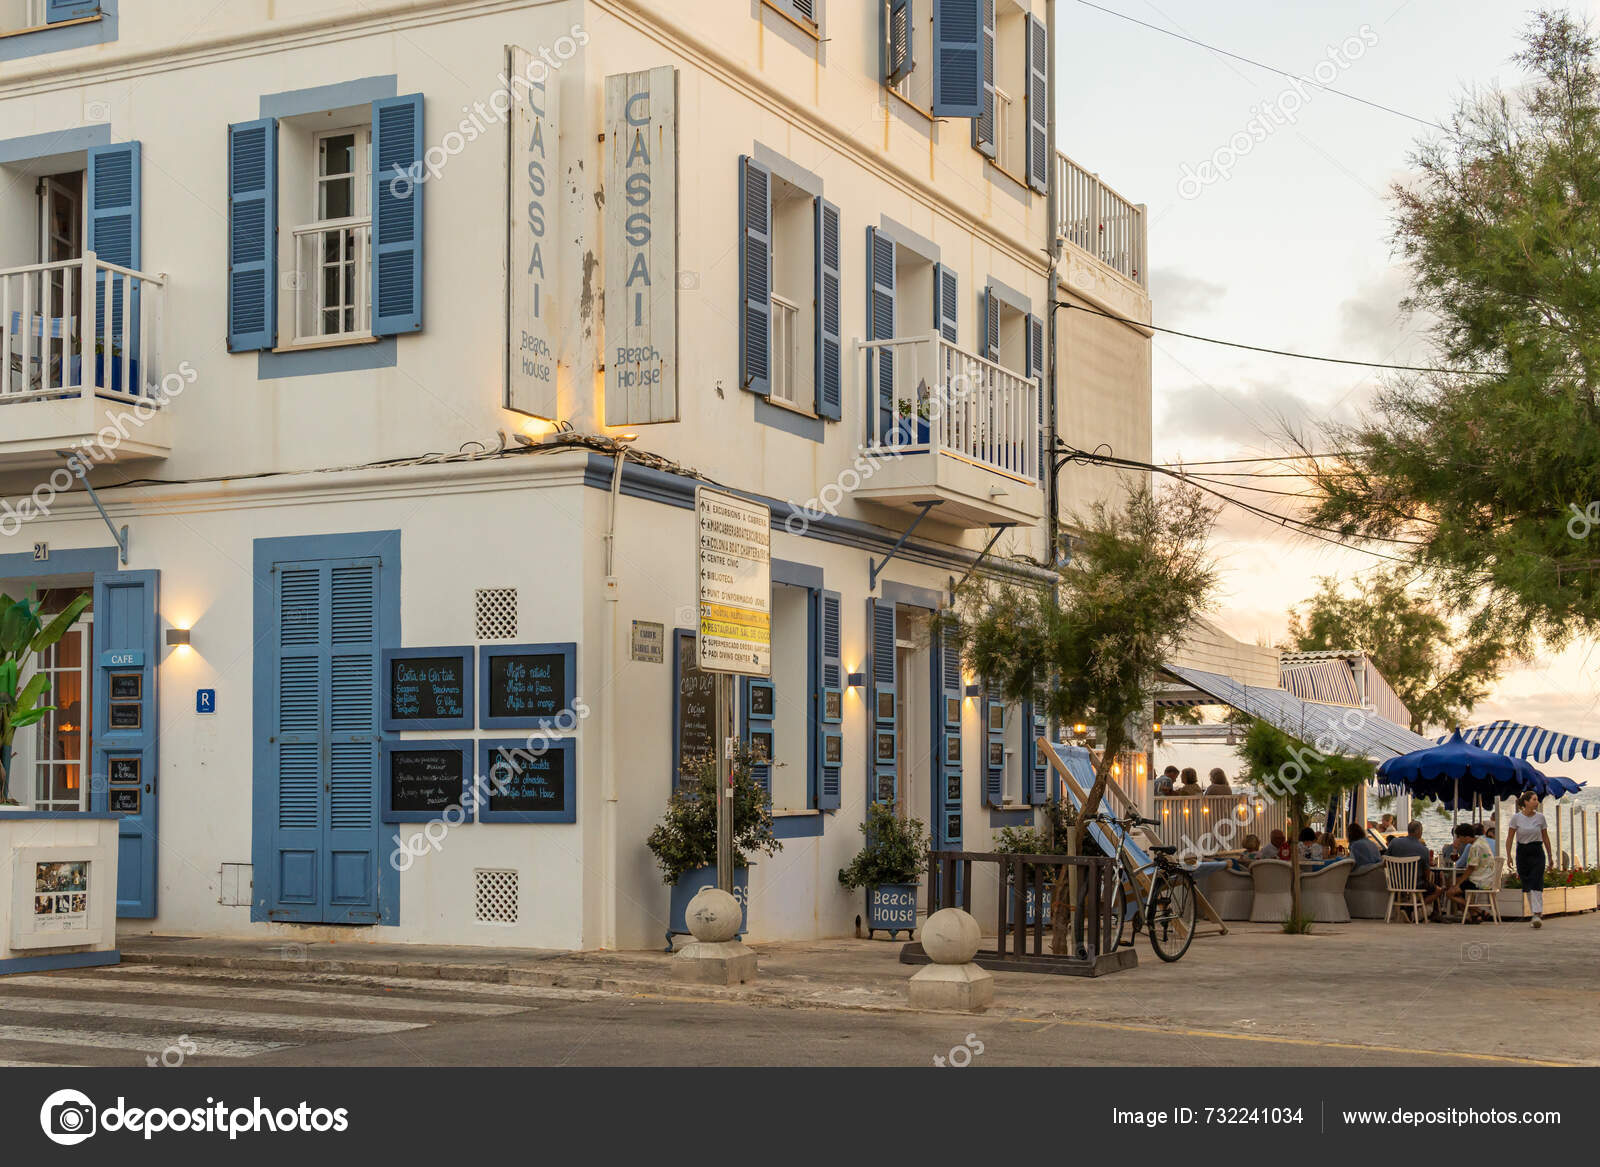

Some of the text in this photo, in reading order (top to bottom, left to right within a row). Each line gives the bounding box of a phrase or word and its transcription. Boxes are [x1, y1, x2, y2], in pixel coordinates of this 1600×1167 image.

[528, 82, 545, 318] CASSAI
[625, 92, 651, 327] CASSAI
[521, 330, 550, 357] Beach
[617, 345, 660, 365] Beach
[712, 504, 741, 520] EXCURSIONS
[748, 514, 767, 527] CABRERA
[34, 543, 47, 560] 21
[707, 554, 725, 566] CENTRE
[707, 571, 734, 584] BIBLIOTECA
[707, 588, 720, 598] PUNT
[707, 622, 739, 637] RESTAURANT
[708, 639, 739, 650] SUPERMERCADO
[708, 650, 750, 662] PADI DIVING CENTER
[201, 692, 210, 706] R
[873, 891, 915, 905] Beach
